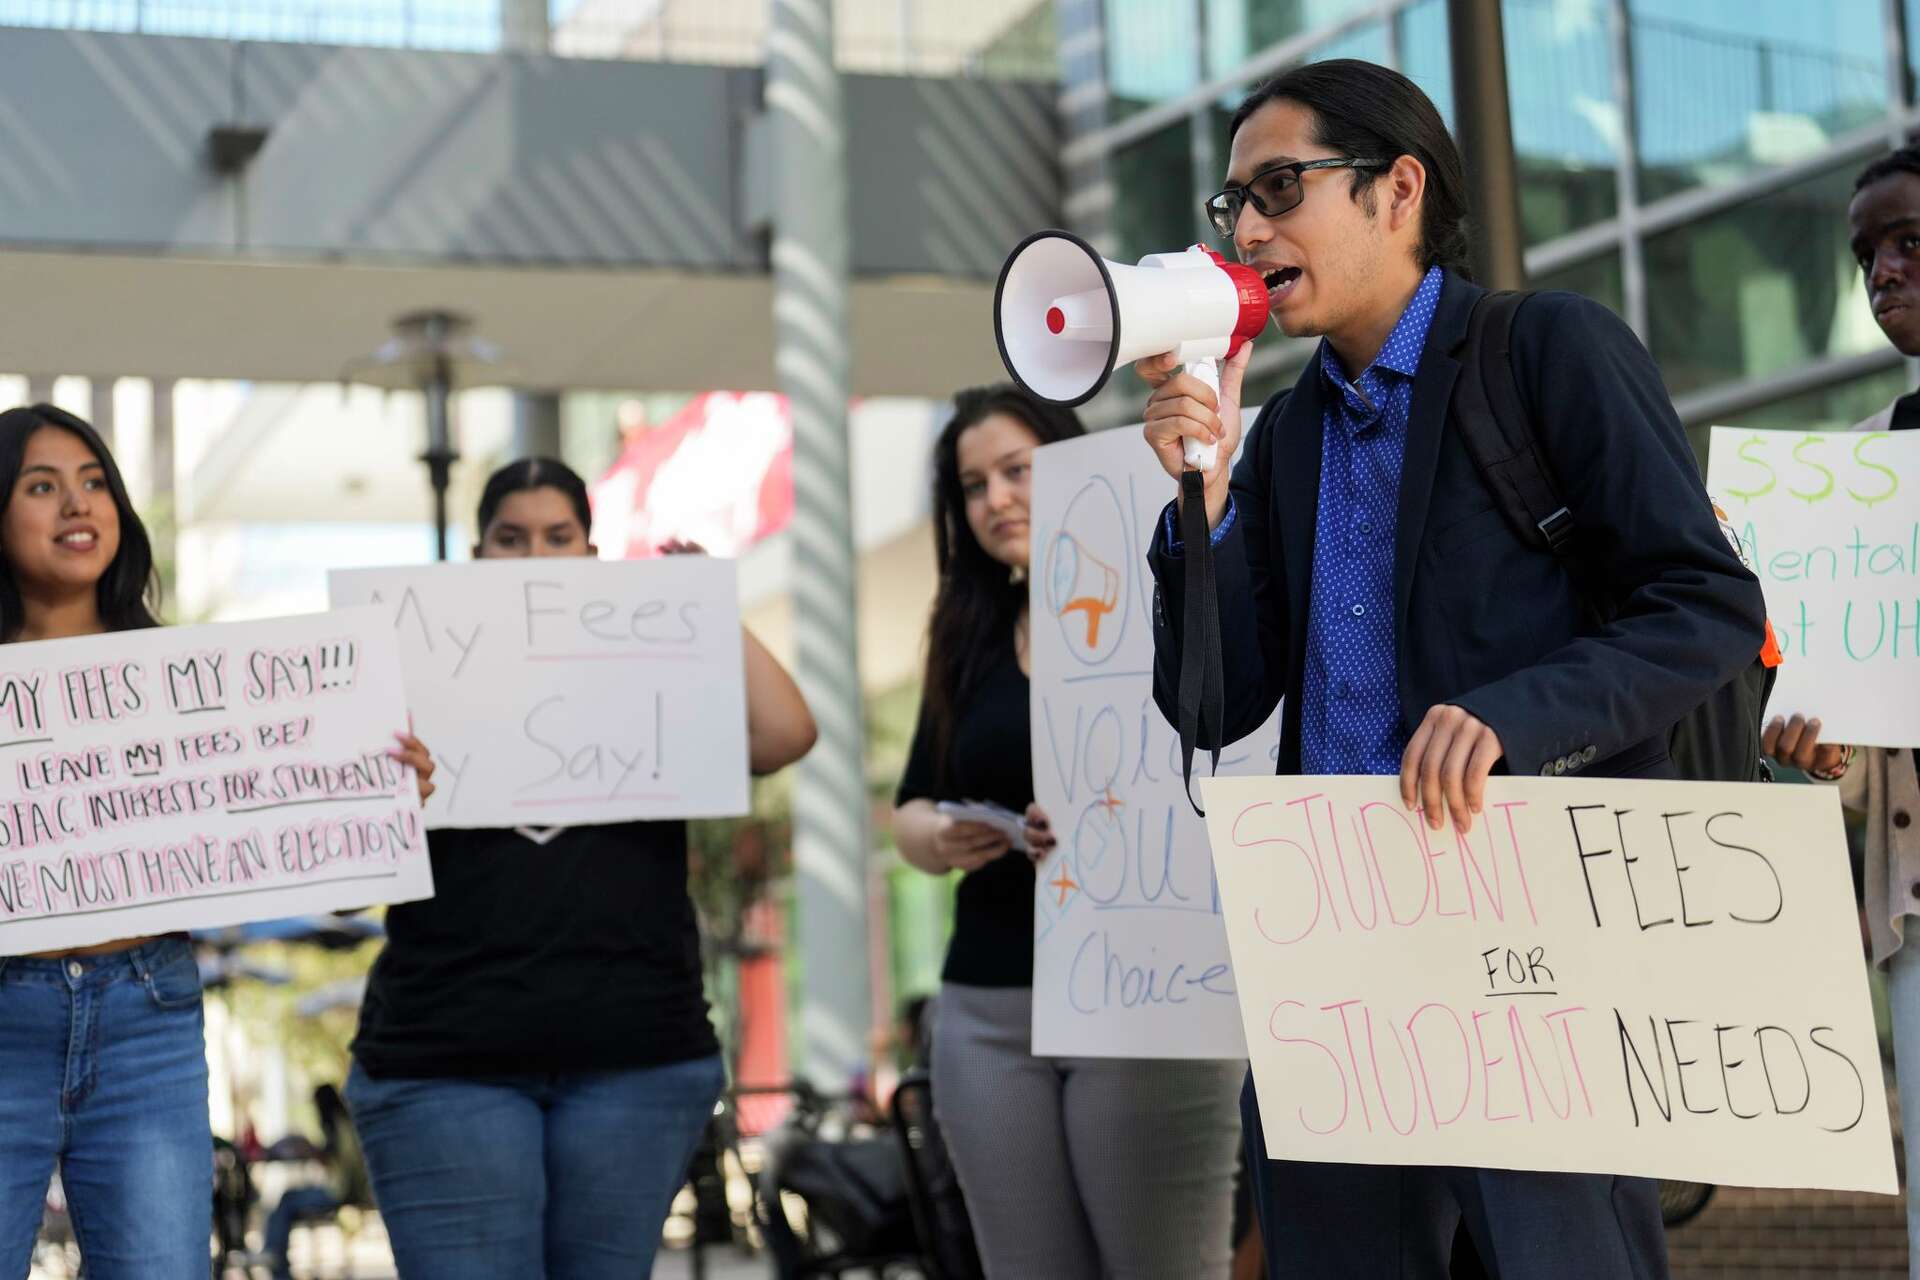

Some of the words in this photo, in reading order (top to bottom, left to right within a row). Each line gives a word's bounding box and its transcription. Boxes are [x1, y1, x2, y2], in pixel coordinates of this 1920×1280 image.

[523, 580, 702, 646] Fees
[65, 663, 141, 719] FEES
[168, 654, 222, 707] MY
[248, 642, 355, 700] SAY!!!
[22, 753, 110, 789] LEAVE
[126, 744, 162, 769] MY
[180, 730, 241, 761] FEES
[258, 720, 309, 747] BE!
[517, 690, 662, 802] Say!
[89, 780, 215, 828] INTERESTS
[224, 770, 266, 802] FOR
[40, 849, 131, 911] MUST
[142, 842, 220, 892] HAVE
[229, 839, 266, 882] AN
[280, 809, 415, 872] ELECTION!
[1233, 794, 1537, 944] STUDENT
[1565, 804, 1783, 930] FEES
[1068, 931, 1235, 1015] Choice
[1481, 946, 1555, 989] FOR
[1269, 1000, 1593, 1135] STUDENT
[1613, 1007, 1865, 1132] NEEDS
